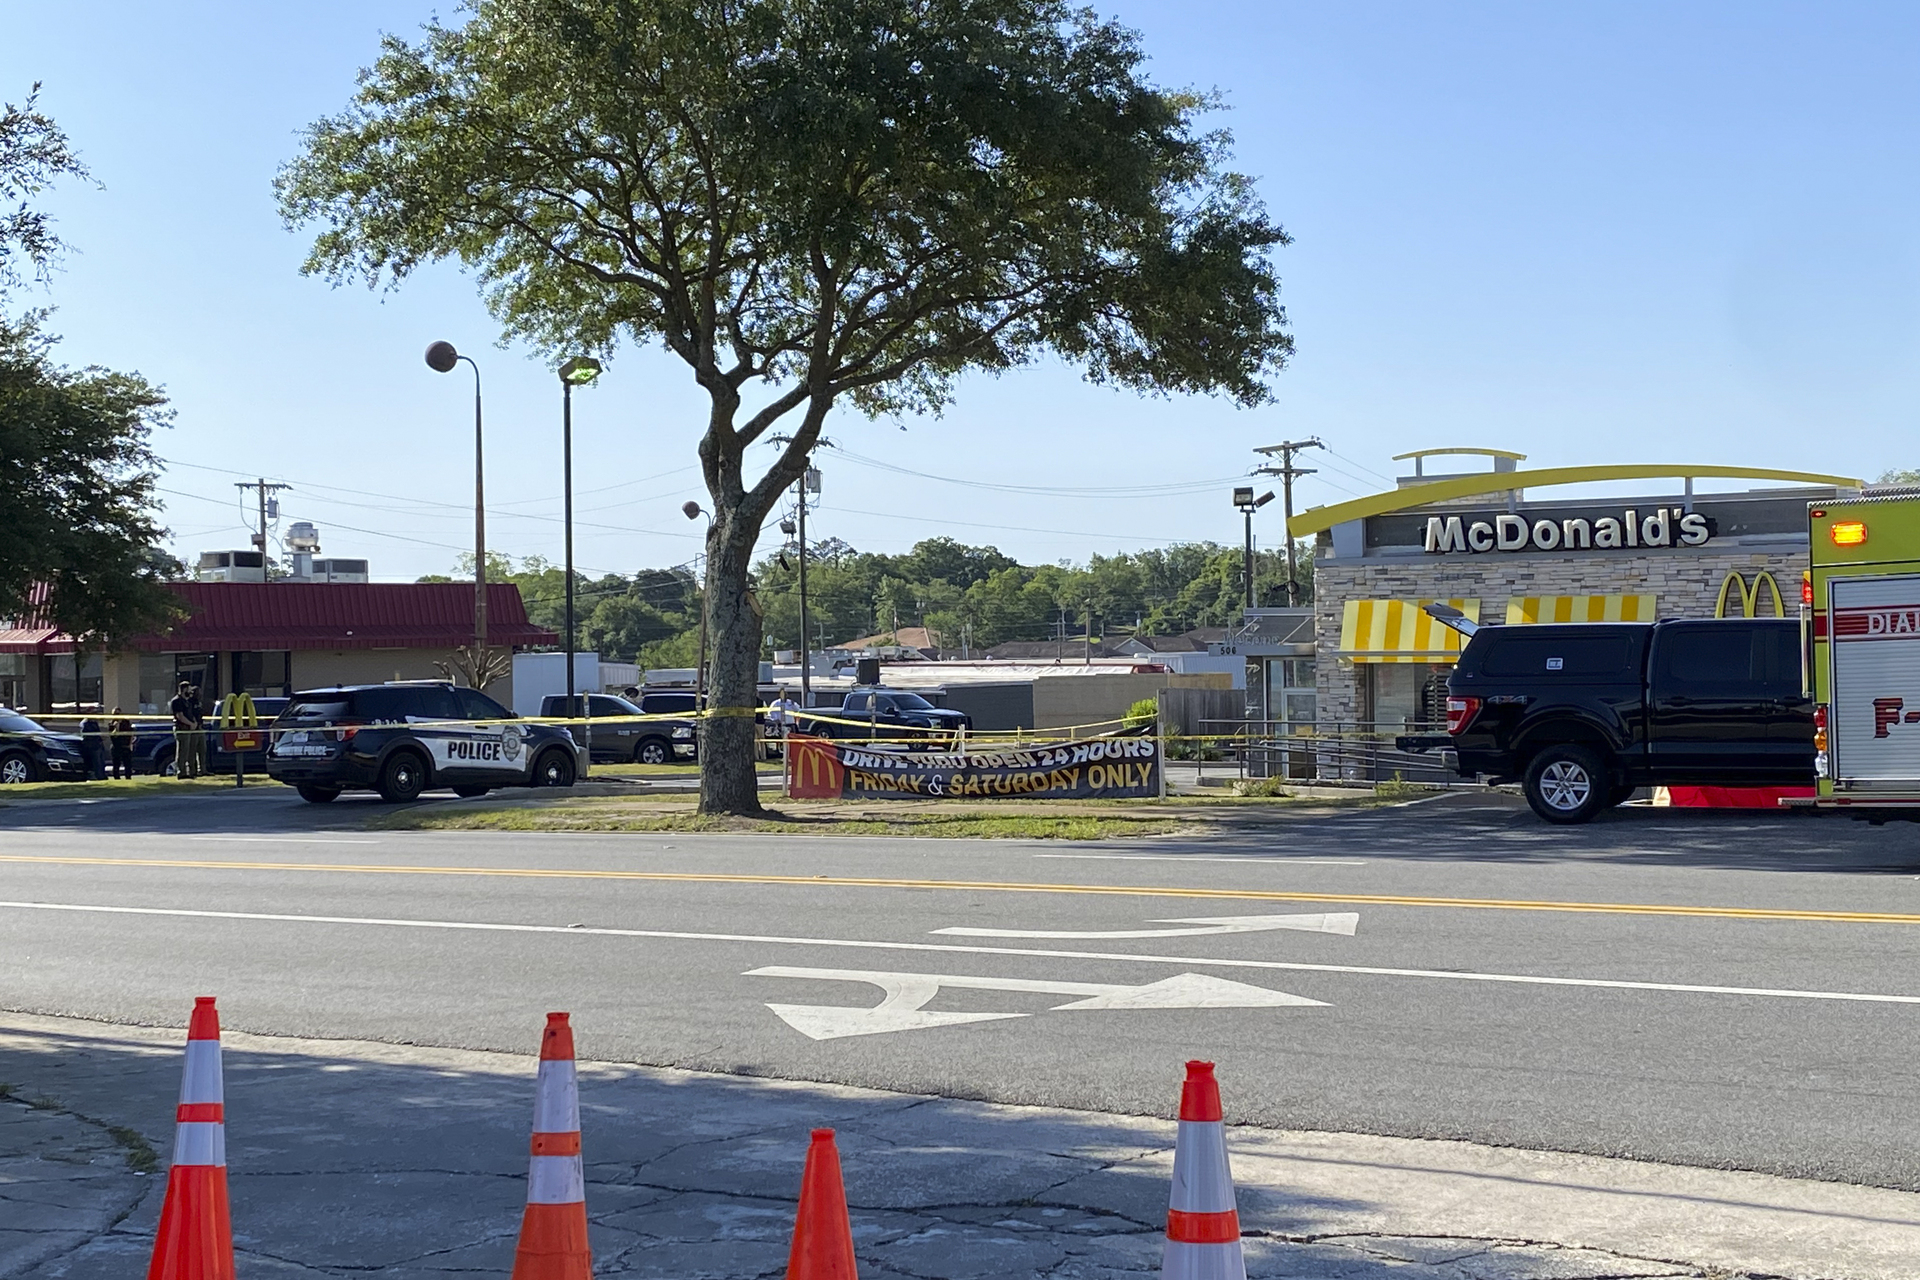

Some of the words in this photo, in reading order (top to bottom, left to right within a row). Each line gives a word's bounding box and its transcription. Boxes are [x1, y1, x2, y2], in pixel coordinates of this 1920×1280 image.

[1424, 507, 1711, 552] McDonald's
[447, 741, 501, 761] POLICE
[843, 750, 908, 769] DRIVE
[971, 753, 1037, 769] OPEN
[1038, 747, 1070, 767] 24
[1071, 738, 1155, 764] HOURS
[850, 770, 926, 793] FRIDAY
[928, 774, 944, 796] &
[948, 768, 1080, 796] SATURDAY
[1087, 762, 1153, 790] ONLY
